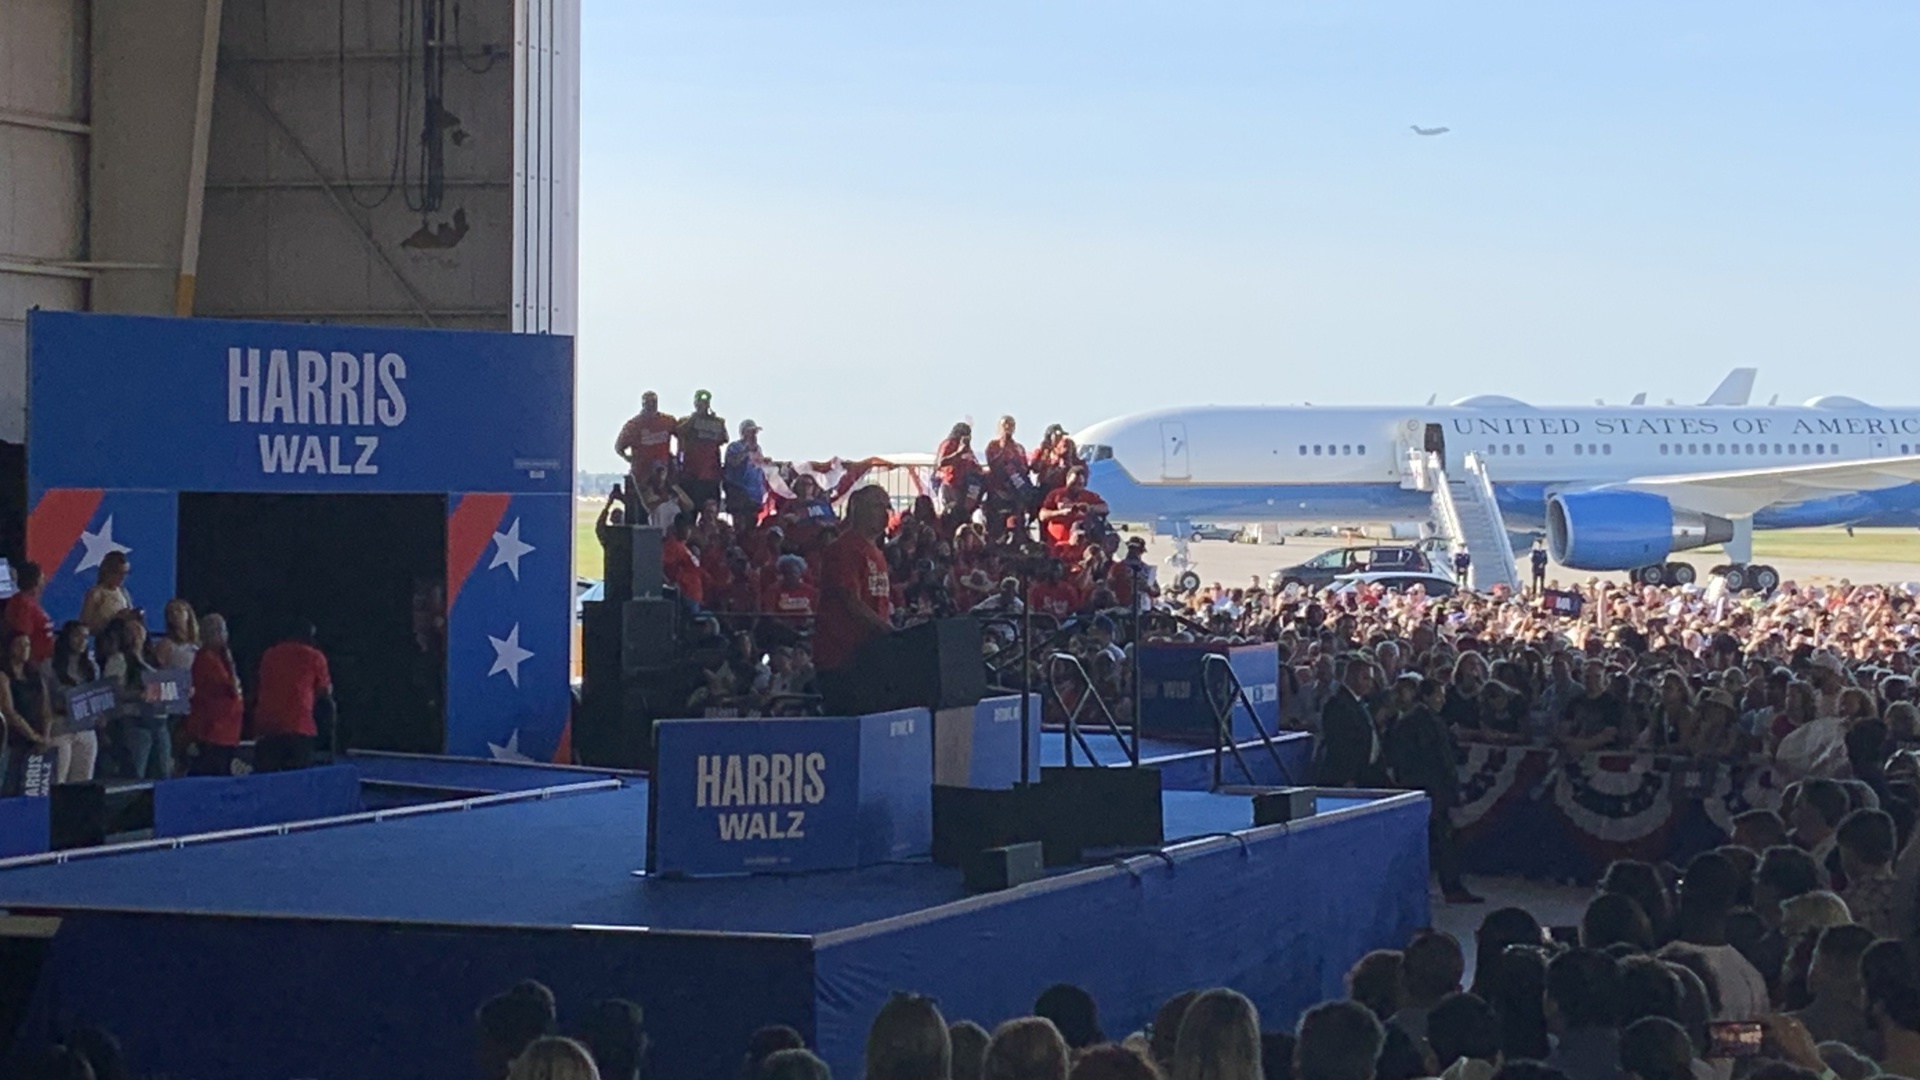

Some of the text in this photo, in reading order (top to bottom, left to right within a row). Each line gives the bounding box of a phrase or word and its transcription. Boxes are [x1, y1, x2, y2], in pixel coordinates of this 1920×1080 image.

[228, 347, 407, 427] HARRIS
[1452, 417, 1920, 435] UNITED STATES OF AMERIC
[258, 434, 379, 475] WALZ
[25, 754, 43, 797] ARRIS
[696, 752, 826, 807] HARRIS
[718, 811, 805, 840] WALZ
